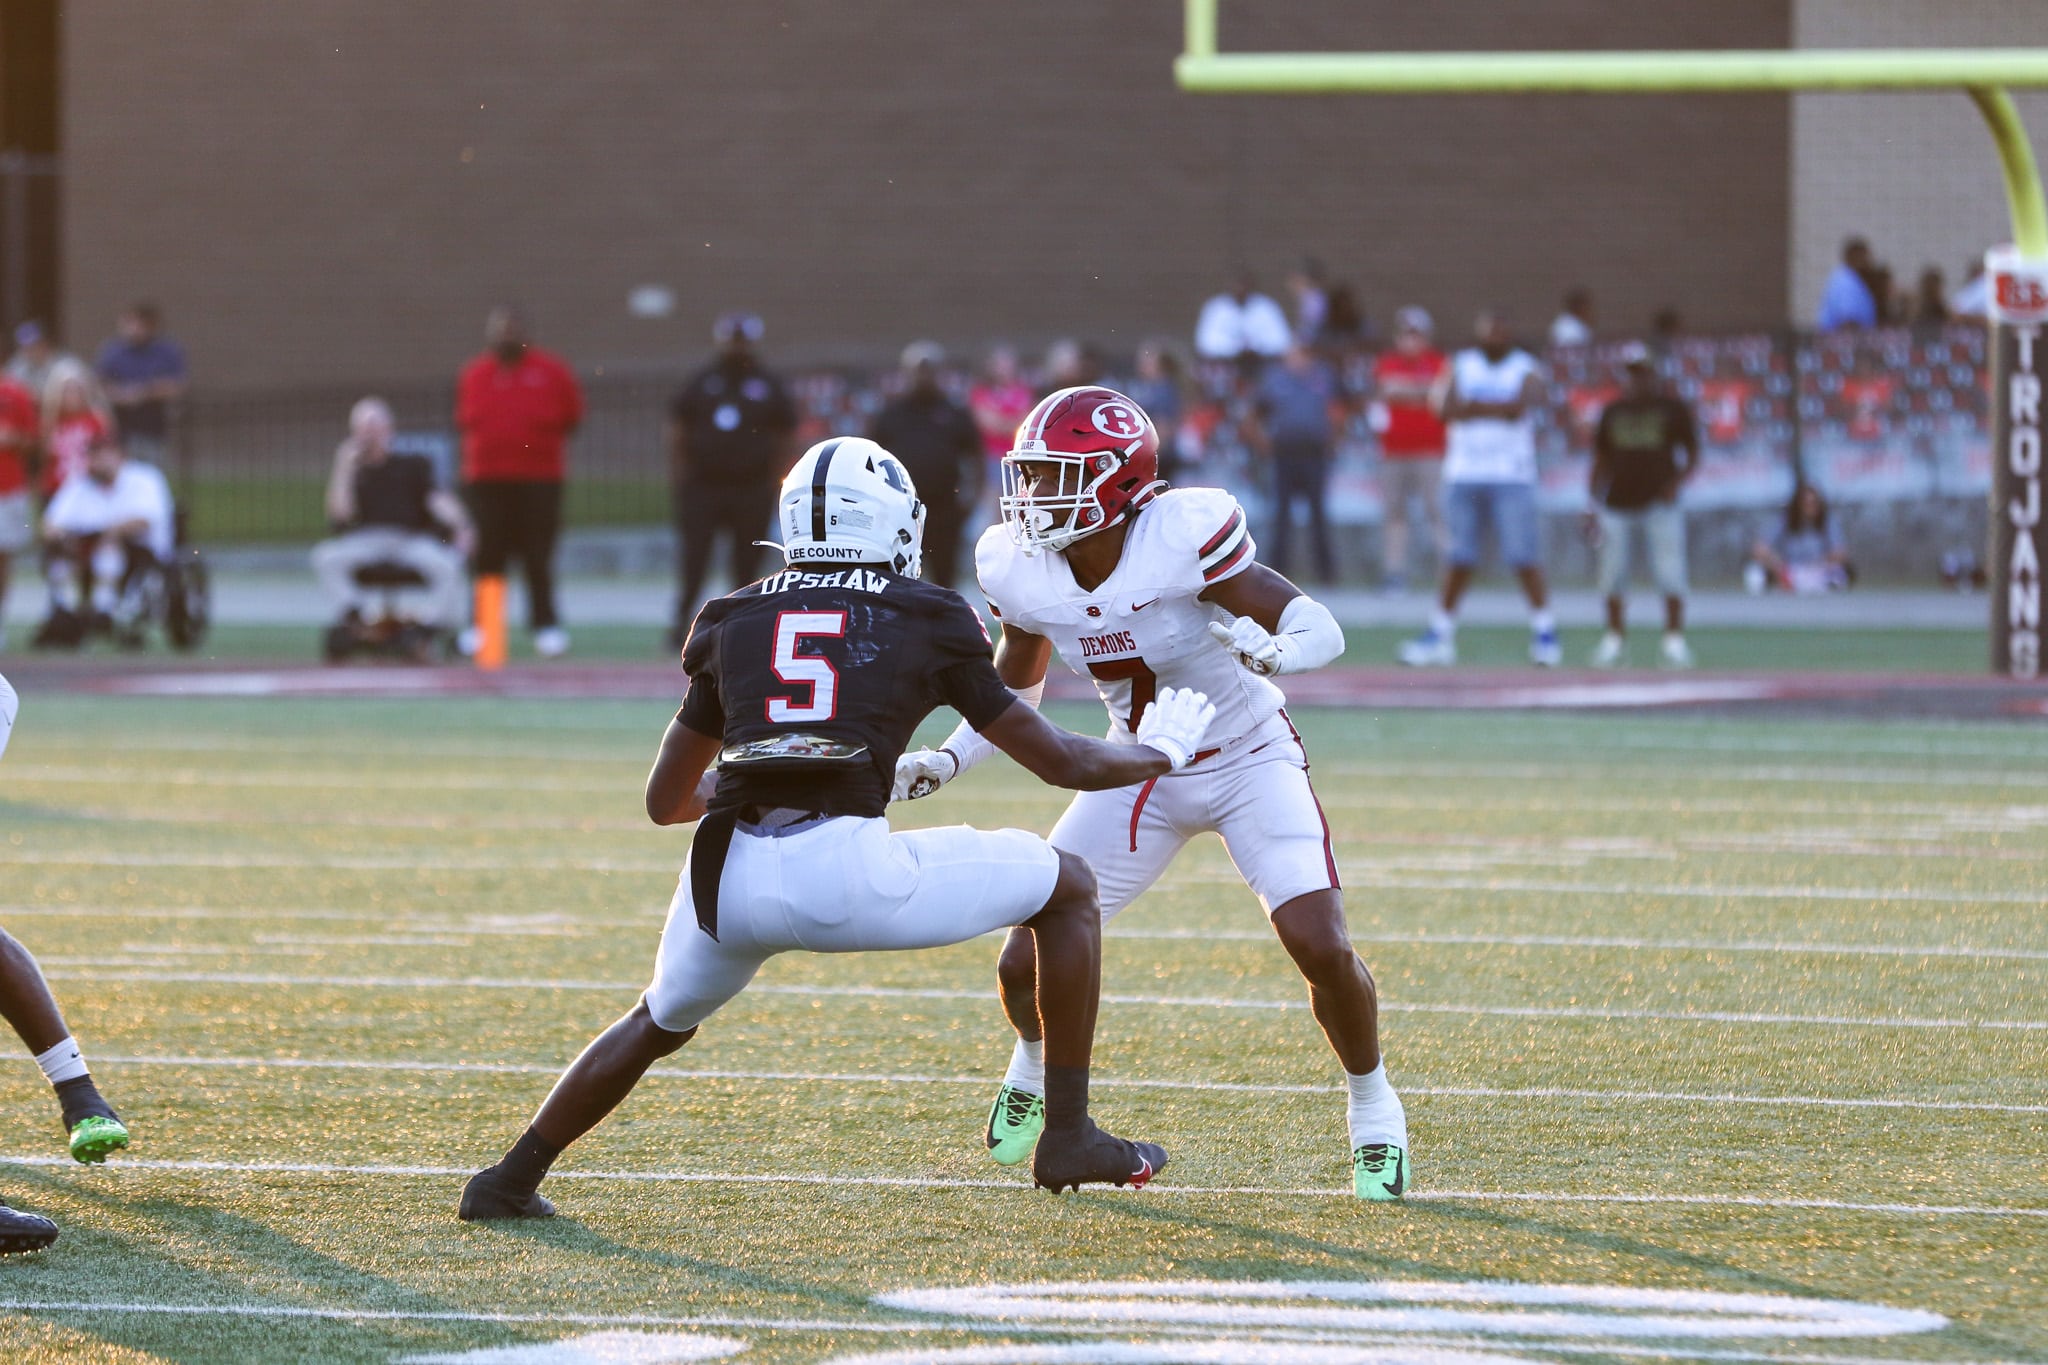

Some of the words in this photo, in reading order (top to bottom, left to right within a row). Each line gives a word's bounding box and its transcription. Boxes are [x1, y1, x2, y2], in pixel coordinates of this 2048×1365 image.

[1098, 404, 1142, 436] R
[830, 514, 838, 527] 5
[788, 547, 806, 561] LEE
[806, 547, 864, 560] COUNTY
[759, 567, 891, 596] UPSHAW
[1078, 630, 1137, 657] DEMONS
[764, 609, 849, 724] 5
[1085, 655, 1157, 735] 7
